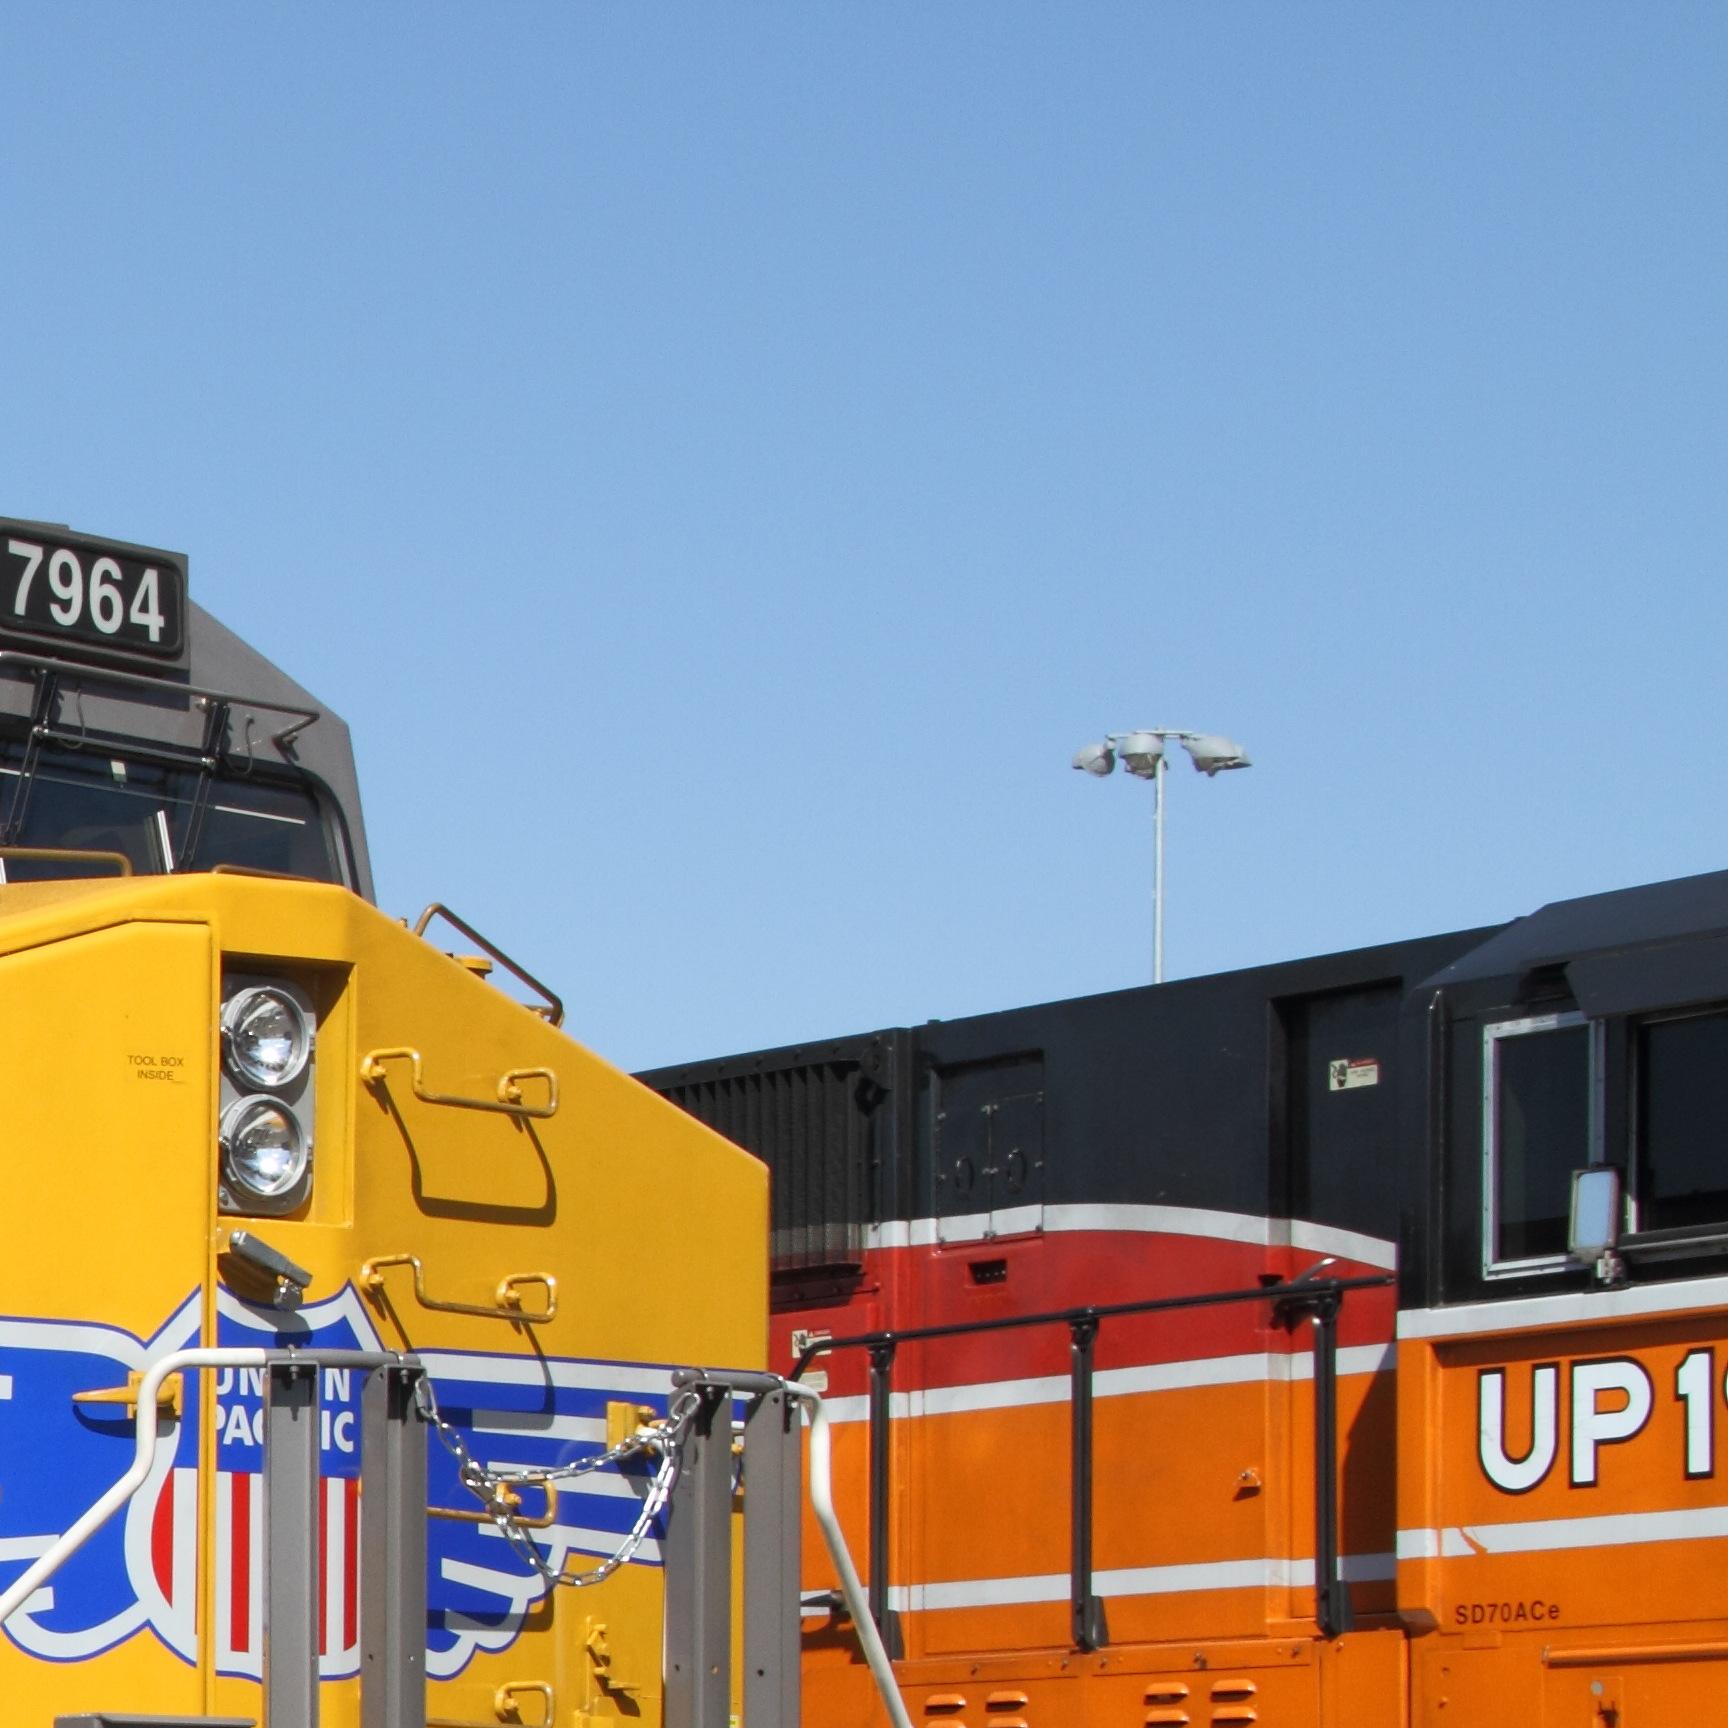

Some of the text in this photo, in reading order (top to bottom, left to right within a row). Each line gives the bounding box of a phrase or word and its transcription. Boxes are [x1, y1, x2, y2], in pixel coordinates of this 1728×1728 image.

[6, 538, 166, 643] 7964
[126, 1055, 184, 1067] TOOL BOX
[136, 1069, 174, 1081] INSIDE
[1455, 1600, 1561, 1626] SD70ACe
